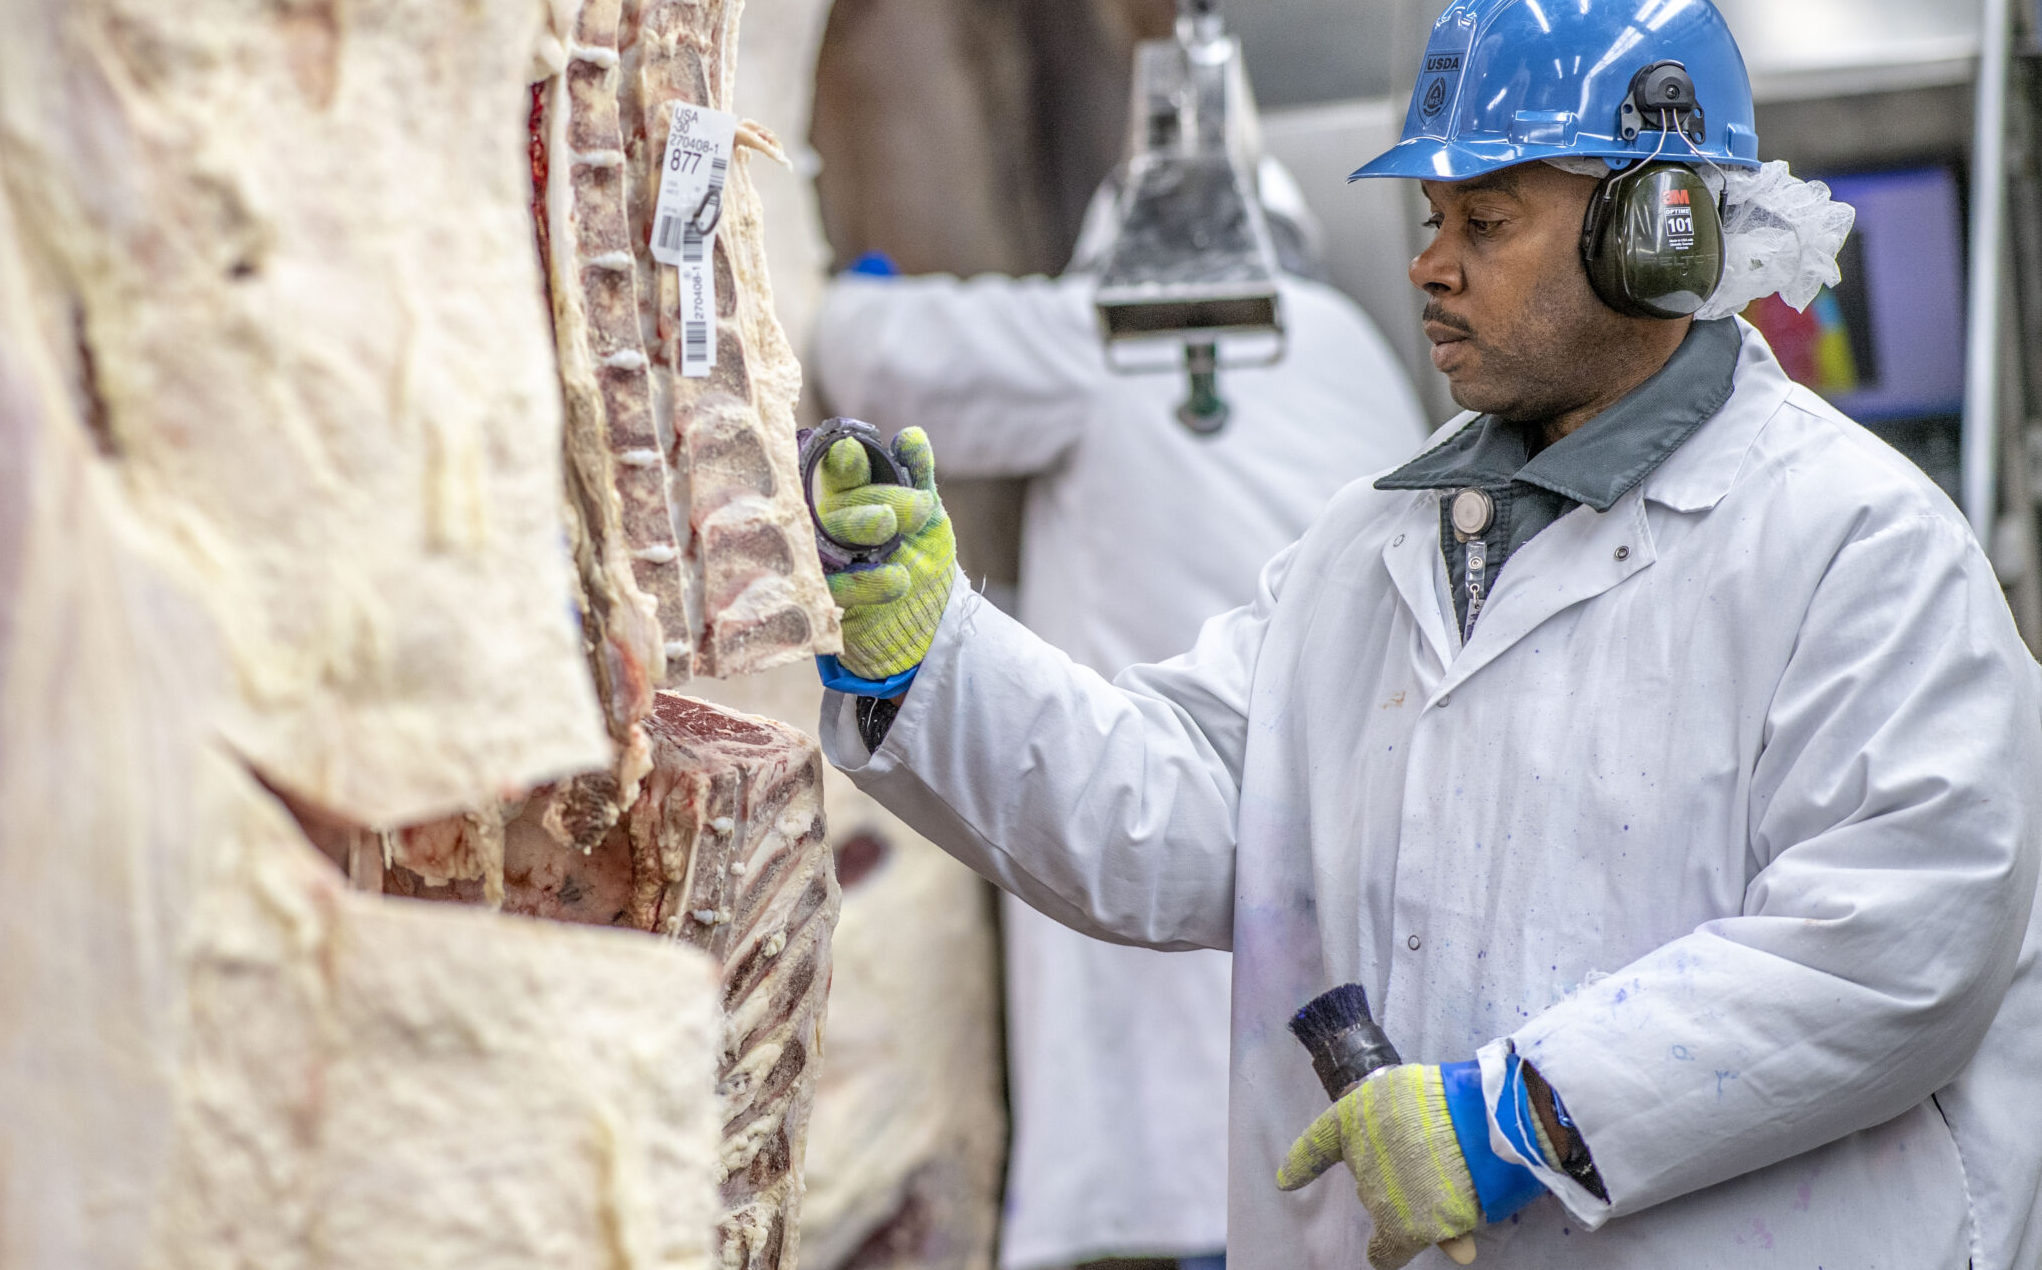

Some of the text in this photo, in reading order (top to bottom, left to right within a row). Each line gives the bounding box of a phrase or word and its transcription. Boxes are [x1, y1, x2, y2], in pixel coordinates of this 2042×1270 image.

[1427, 57, 1459, 70] USDA
[675, 107, 698, 123] USA
[670, 133, 719, 154] 270408-1
[670, 148, 702, 174] 877
[1662, 189, 1690, 205] 3M
[1667, 217, 1692, 233] 101
[692, 266, 704, 319] 270408-1
